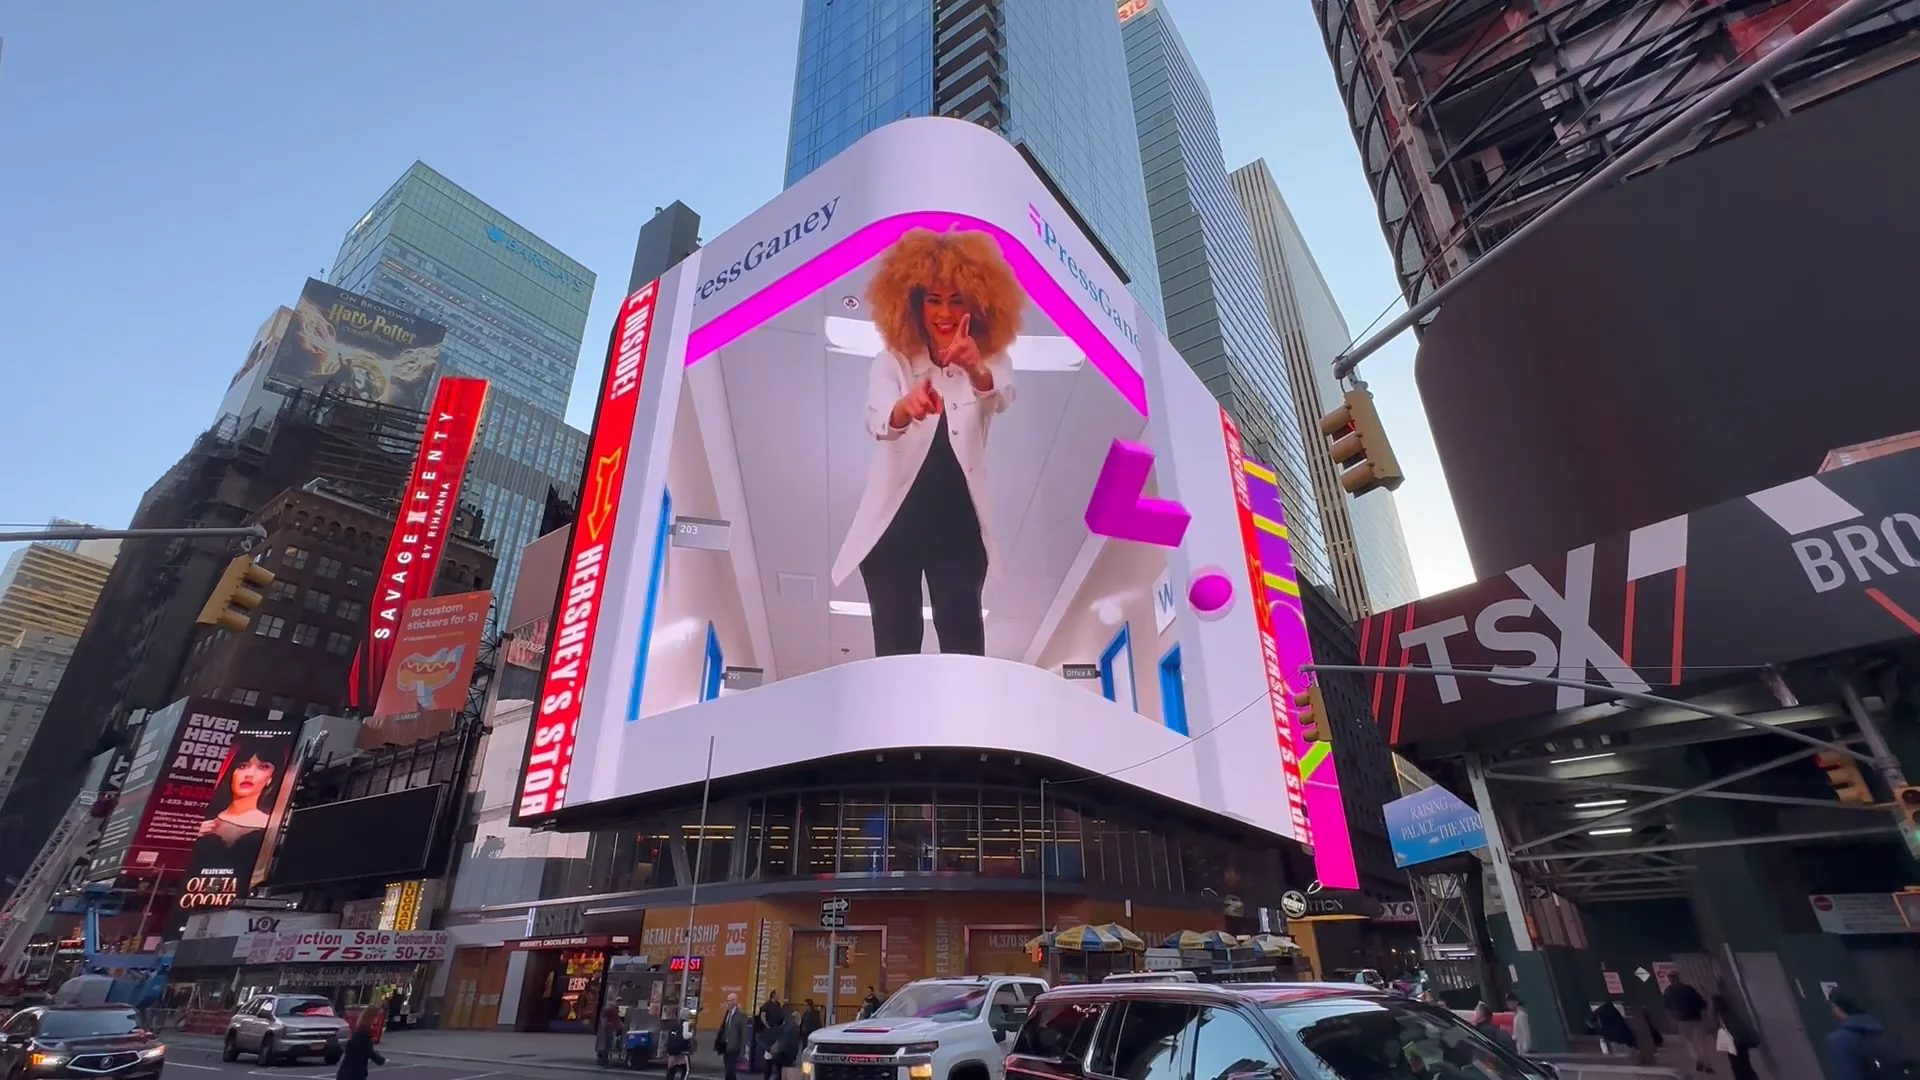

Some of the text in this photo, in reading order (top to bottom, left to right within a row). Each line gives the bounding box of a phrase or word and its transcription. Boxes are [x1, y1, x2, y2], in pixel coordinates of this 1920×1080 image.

[506, 239, 584, 293] BARCLAYS
[340, 292, 416, 324] ON BROADWAY
[327, 303, 417, 345] Harry Potter
[610, 304, 650, 400] INSIDE!
[374, 534, 418, 639] SAVAGE
[416, 411, 453, 501] FENTY
[421, 482, 450, 559] BY RIHANNA
[680, 525, 698, 535] 203
[1158, 583, 1173, 615] W
[407, 612, 479, 631] stickers for $1
[411, 604, 463, 618] 10 custom
[542, 543, 603, 716] HERSHEY'S
[1398, 543, 1653, 712] TSX
[728, 672, 741, 680] 205
[1262, 630, 1296, 765] HERSHEY'S
[172, 756, 188, 769] A
[1410, 797, 1449, 820] RAISING
[1401, 819, 1437, 841] PALACE
[354, 931, 390, 945] Sale
[543, 938, 570, 947] CHOCOLATE
[570, 937, 588, 946] WORLD
[643, 927, 671, 945] RETAIL
[726, 928, 747, 944] 705
[937, 917, 949, 974] FLAGSHIP
[989, 935, 1016, 947] 14,370
[693, 944, 716, 958] EASE
